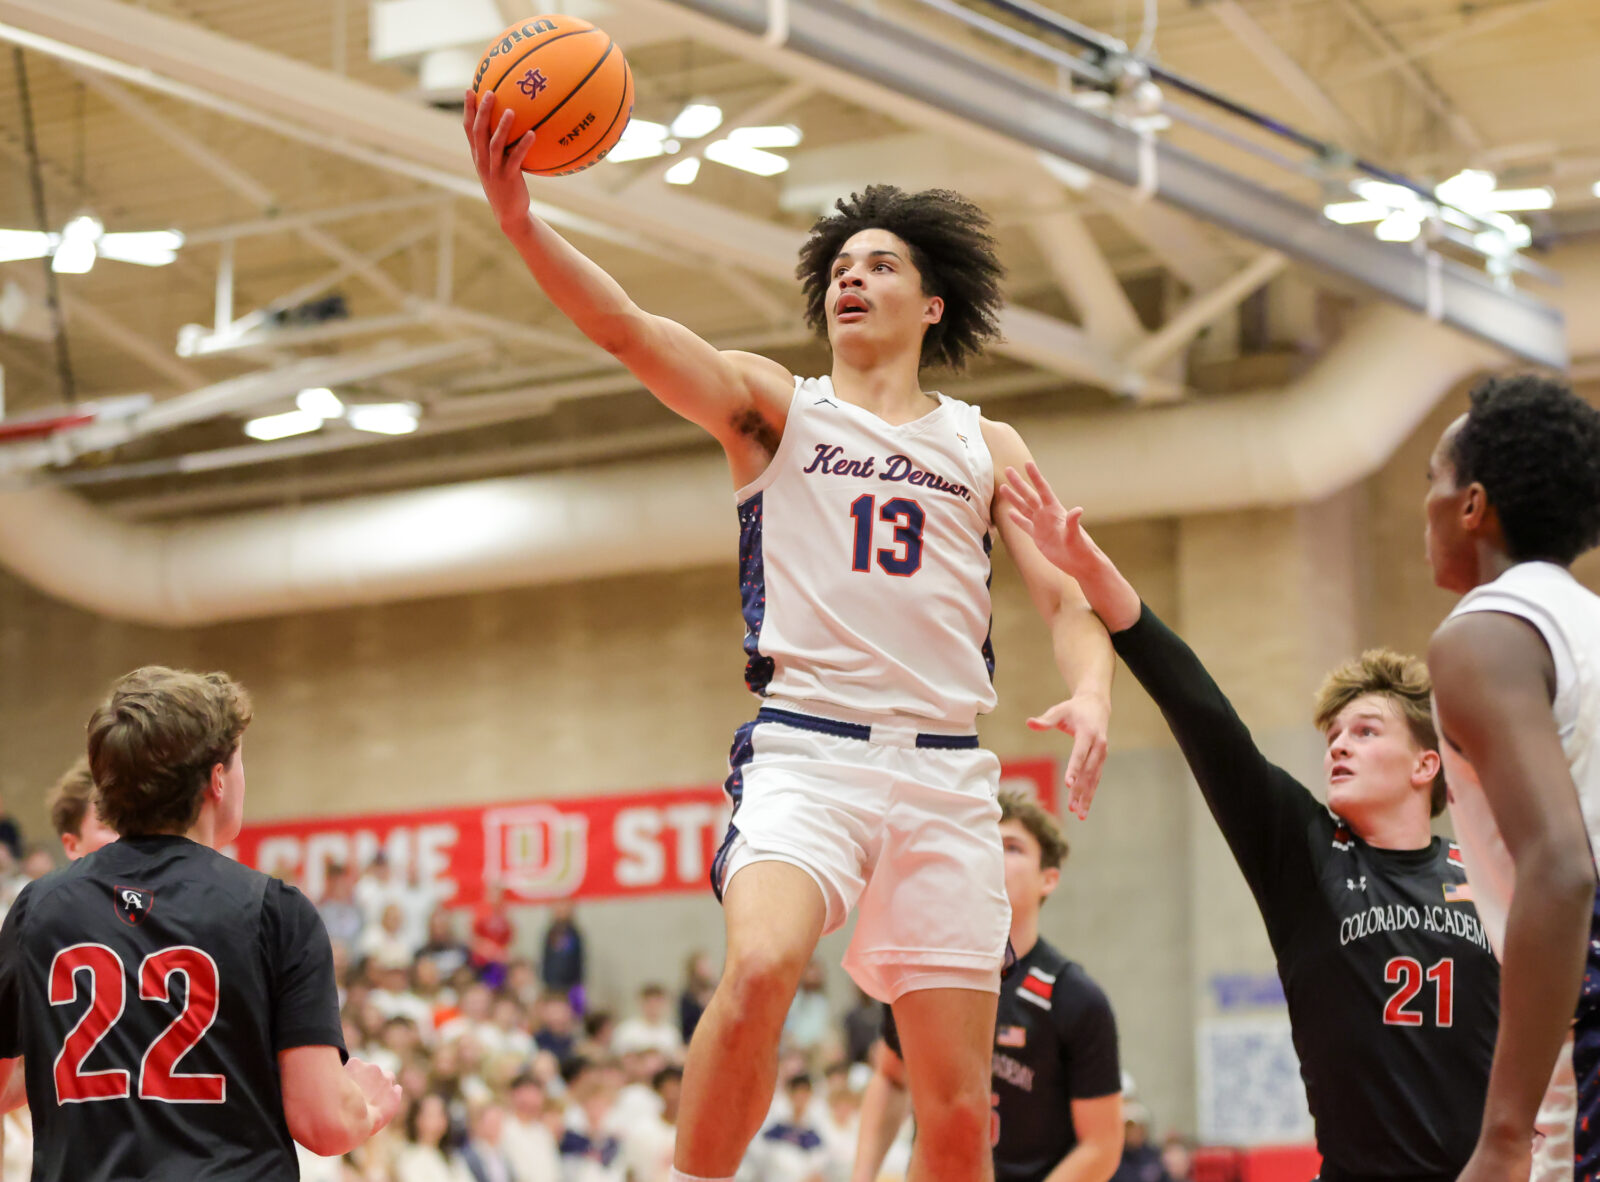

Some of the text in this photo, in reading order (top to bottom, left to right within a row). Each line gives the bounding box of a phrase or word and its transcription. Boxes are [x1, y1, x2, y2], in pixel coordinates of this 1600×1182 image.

[472, 18, 558, 94] Wilson
[566, 112, 596, 142] NFHS
[803, 443, 971, 502] Kent Denver
[849, 493, 926, 578] 13
[612, 799, 728, 887] ST
[1339, 904, 1420, 946] COLORADO
[47, 942, 227, 1107] 22
[1382, 955, 1454, 1028] 21
